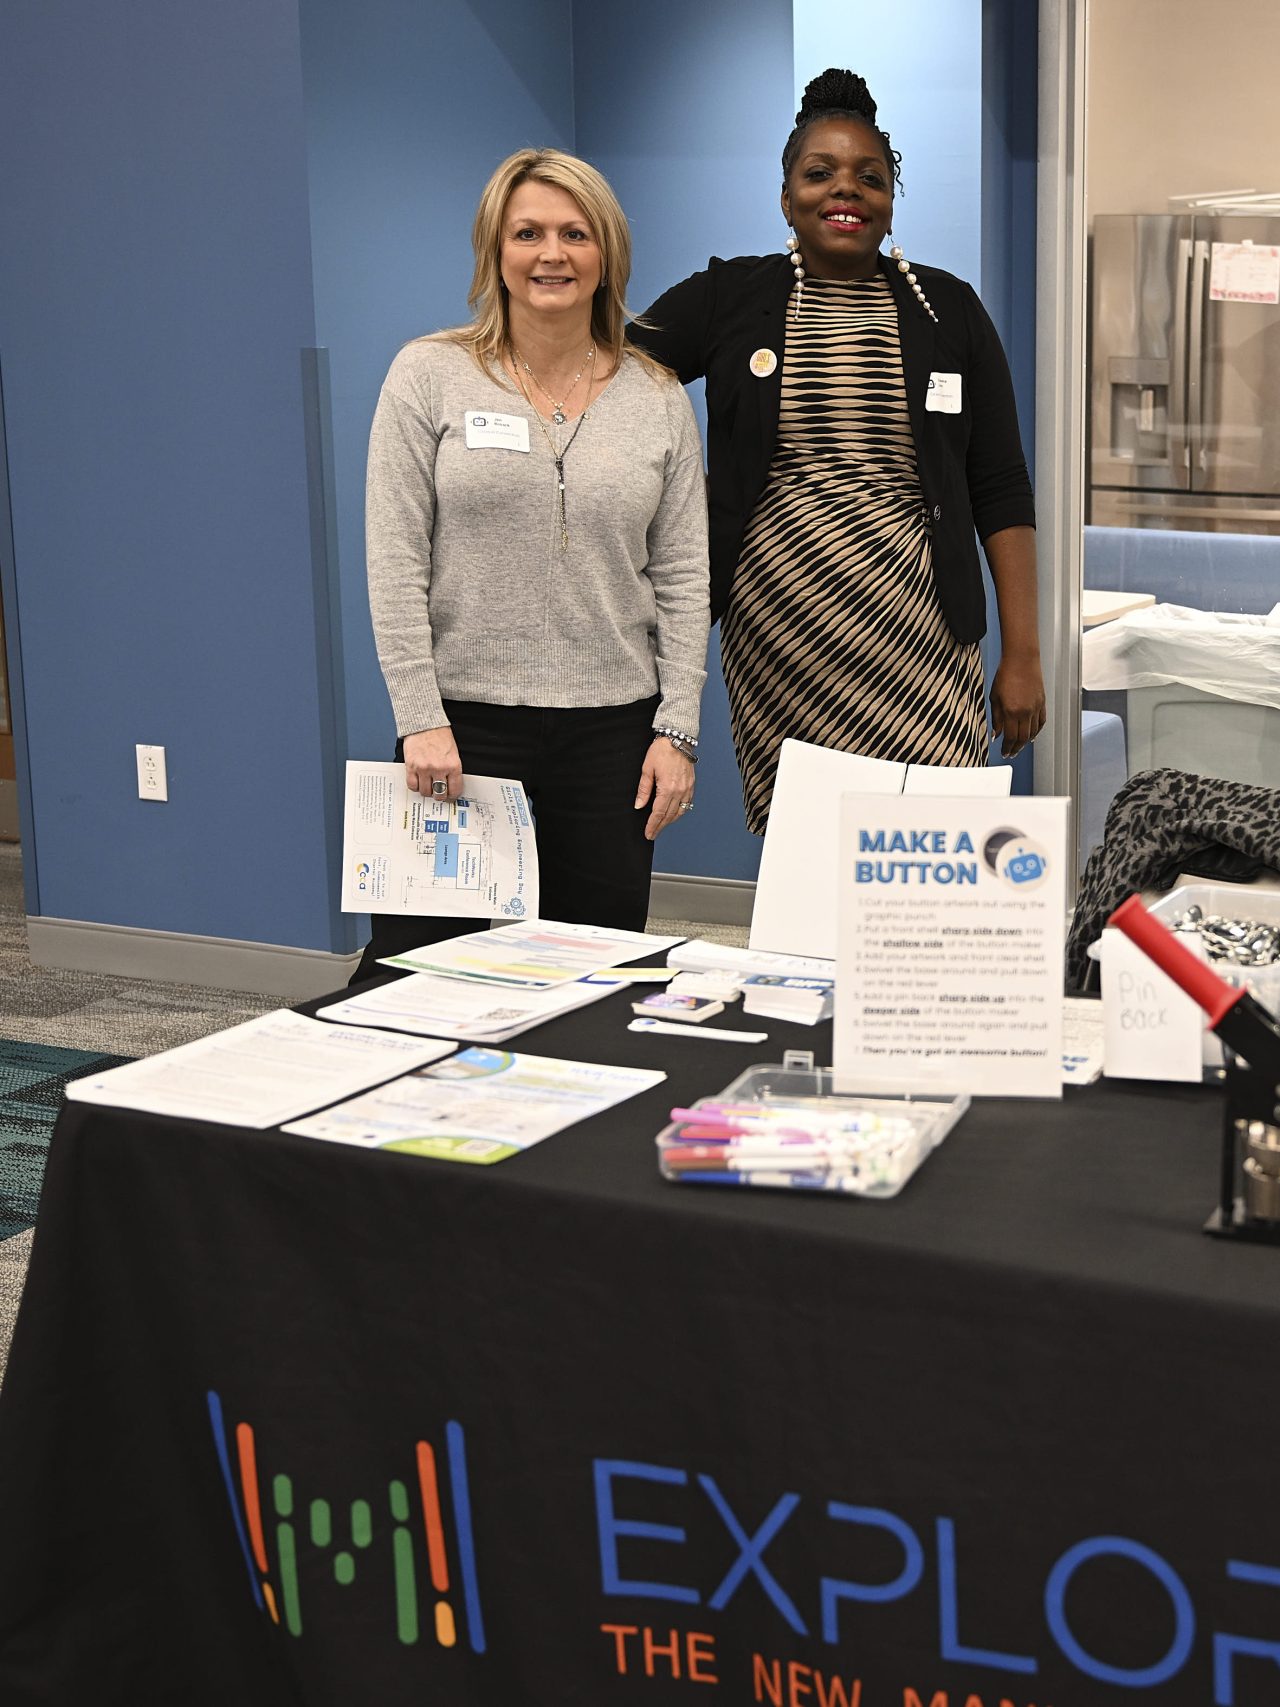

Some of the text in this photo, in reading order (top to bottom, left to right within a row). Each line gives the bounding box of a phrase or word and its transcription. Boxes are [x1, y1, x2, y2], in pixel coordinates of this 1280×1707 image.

[511, 805, 521, 836] Exploring
[858, 830, 974, 853] MAKE A
[855, 861, 977, 884] BUTTON
[942, 927, 970, 936] sharp
[973, 927, 993, 936] side
[996, 928, 1023, 936] down
[883, 939, 920, 948] shallow
[924, 940, 944, 948] side
[1117, 970, 1157, 1003] Pin
[939, 994, 966, 1004] sharp
[970, 994, 990, 1002] side
[992, 995, 1005, 1004] up
[863, 1007, 898, 1016] deeper
[900, 1007, 920, 1015] side
[863, 1046, 887, 1054] Then
[889, 1046, 923, 1056] you've
[926, 1047, 942, 1056] got
[601, 1624, 861, 1707] THE NEW
